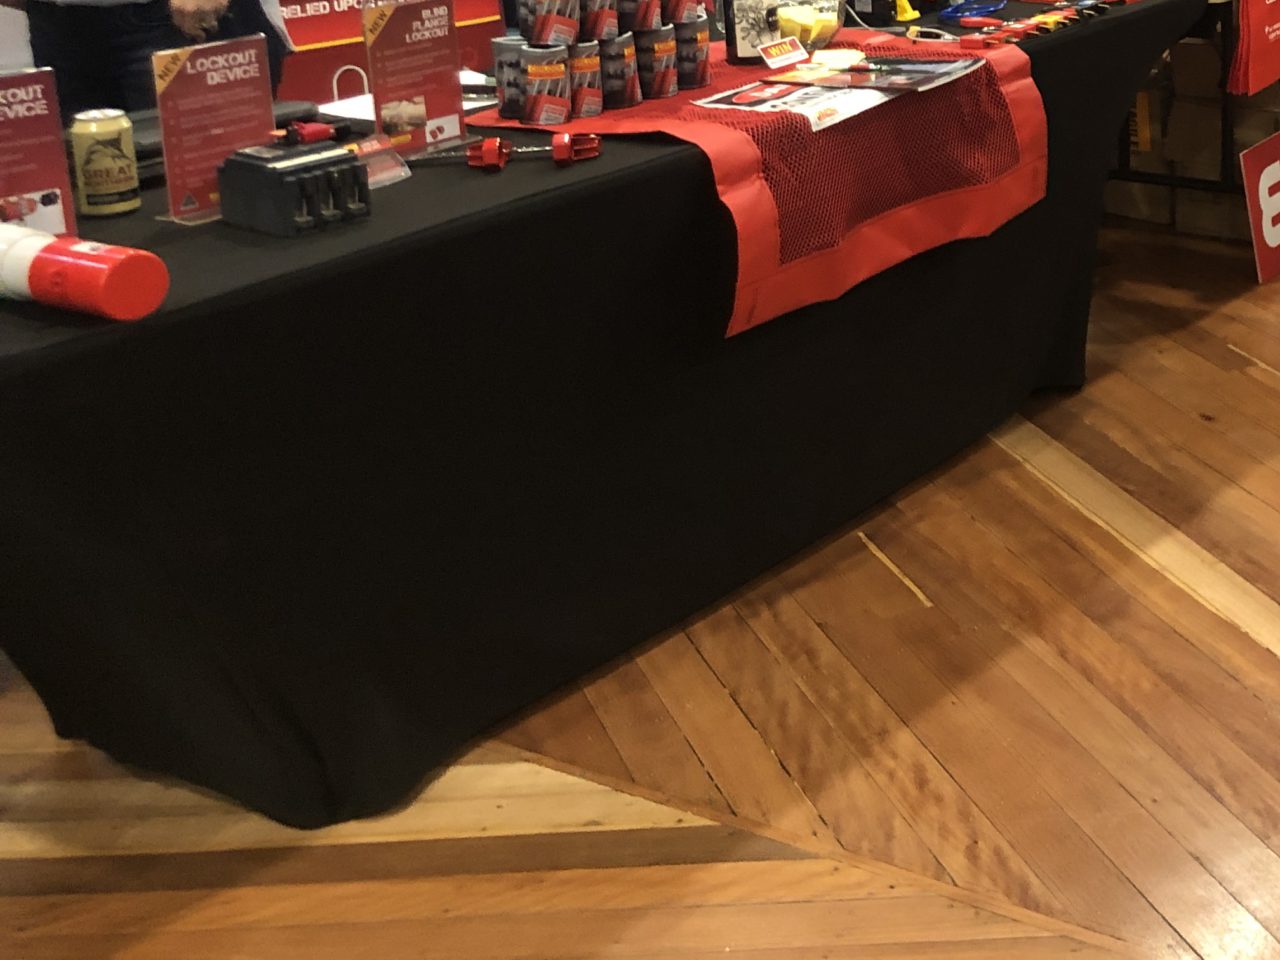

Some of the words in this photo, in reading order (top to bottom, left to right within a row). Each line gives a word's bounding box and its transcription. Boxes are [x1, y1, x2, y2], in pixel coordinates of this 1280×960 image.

[280, 1, 330, 20] RELIED
[369, 10, 388, 35] NEW
[405, 26, 449, 43] LOCKOUT
[767, 42, 793, 57] WIN
[158, 53, 182, 82] NEW
[186, 49, 258, 74] LOCKOUT
[206, 66, 261, 85] DEVICE
